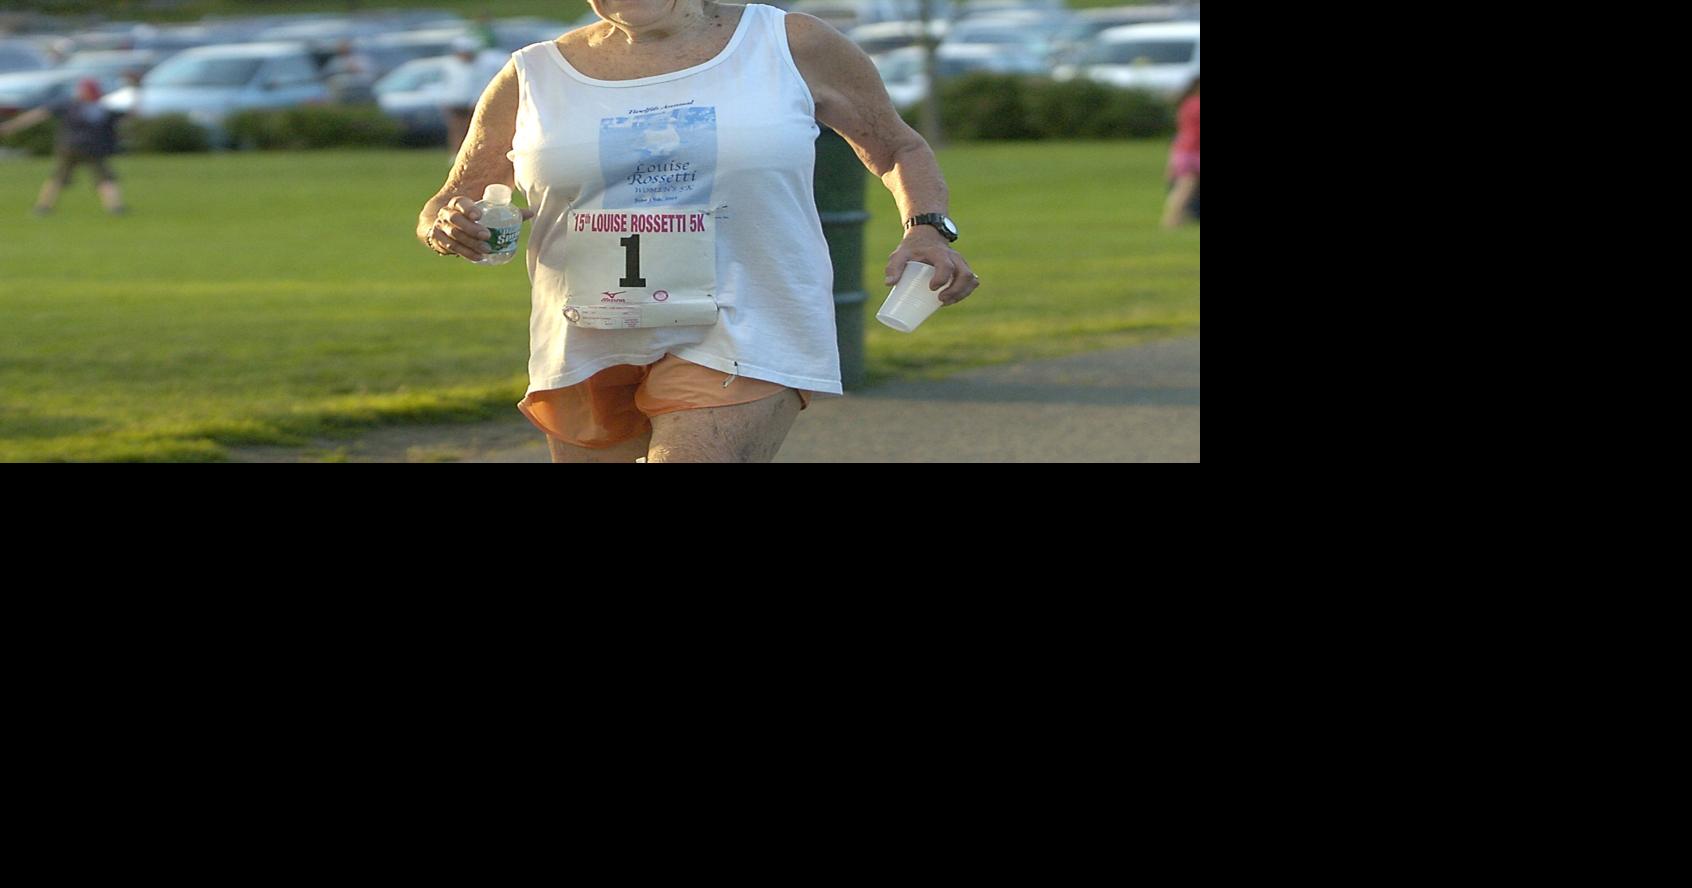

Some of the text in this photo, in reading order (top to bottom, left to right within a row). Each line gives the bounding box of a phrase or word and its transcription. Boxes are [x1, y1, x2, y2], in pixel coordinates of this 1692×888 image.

[634, 160, 690, 174] Louise
[627, 170, 697, 185] Rossetti
[591, 214, 627, 232] LOUISE
[631, 214, 686, 232] ROSSETTI
[689, 214, 705, 232] 5K
[619, 234, 646, 288] 1
